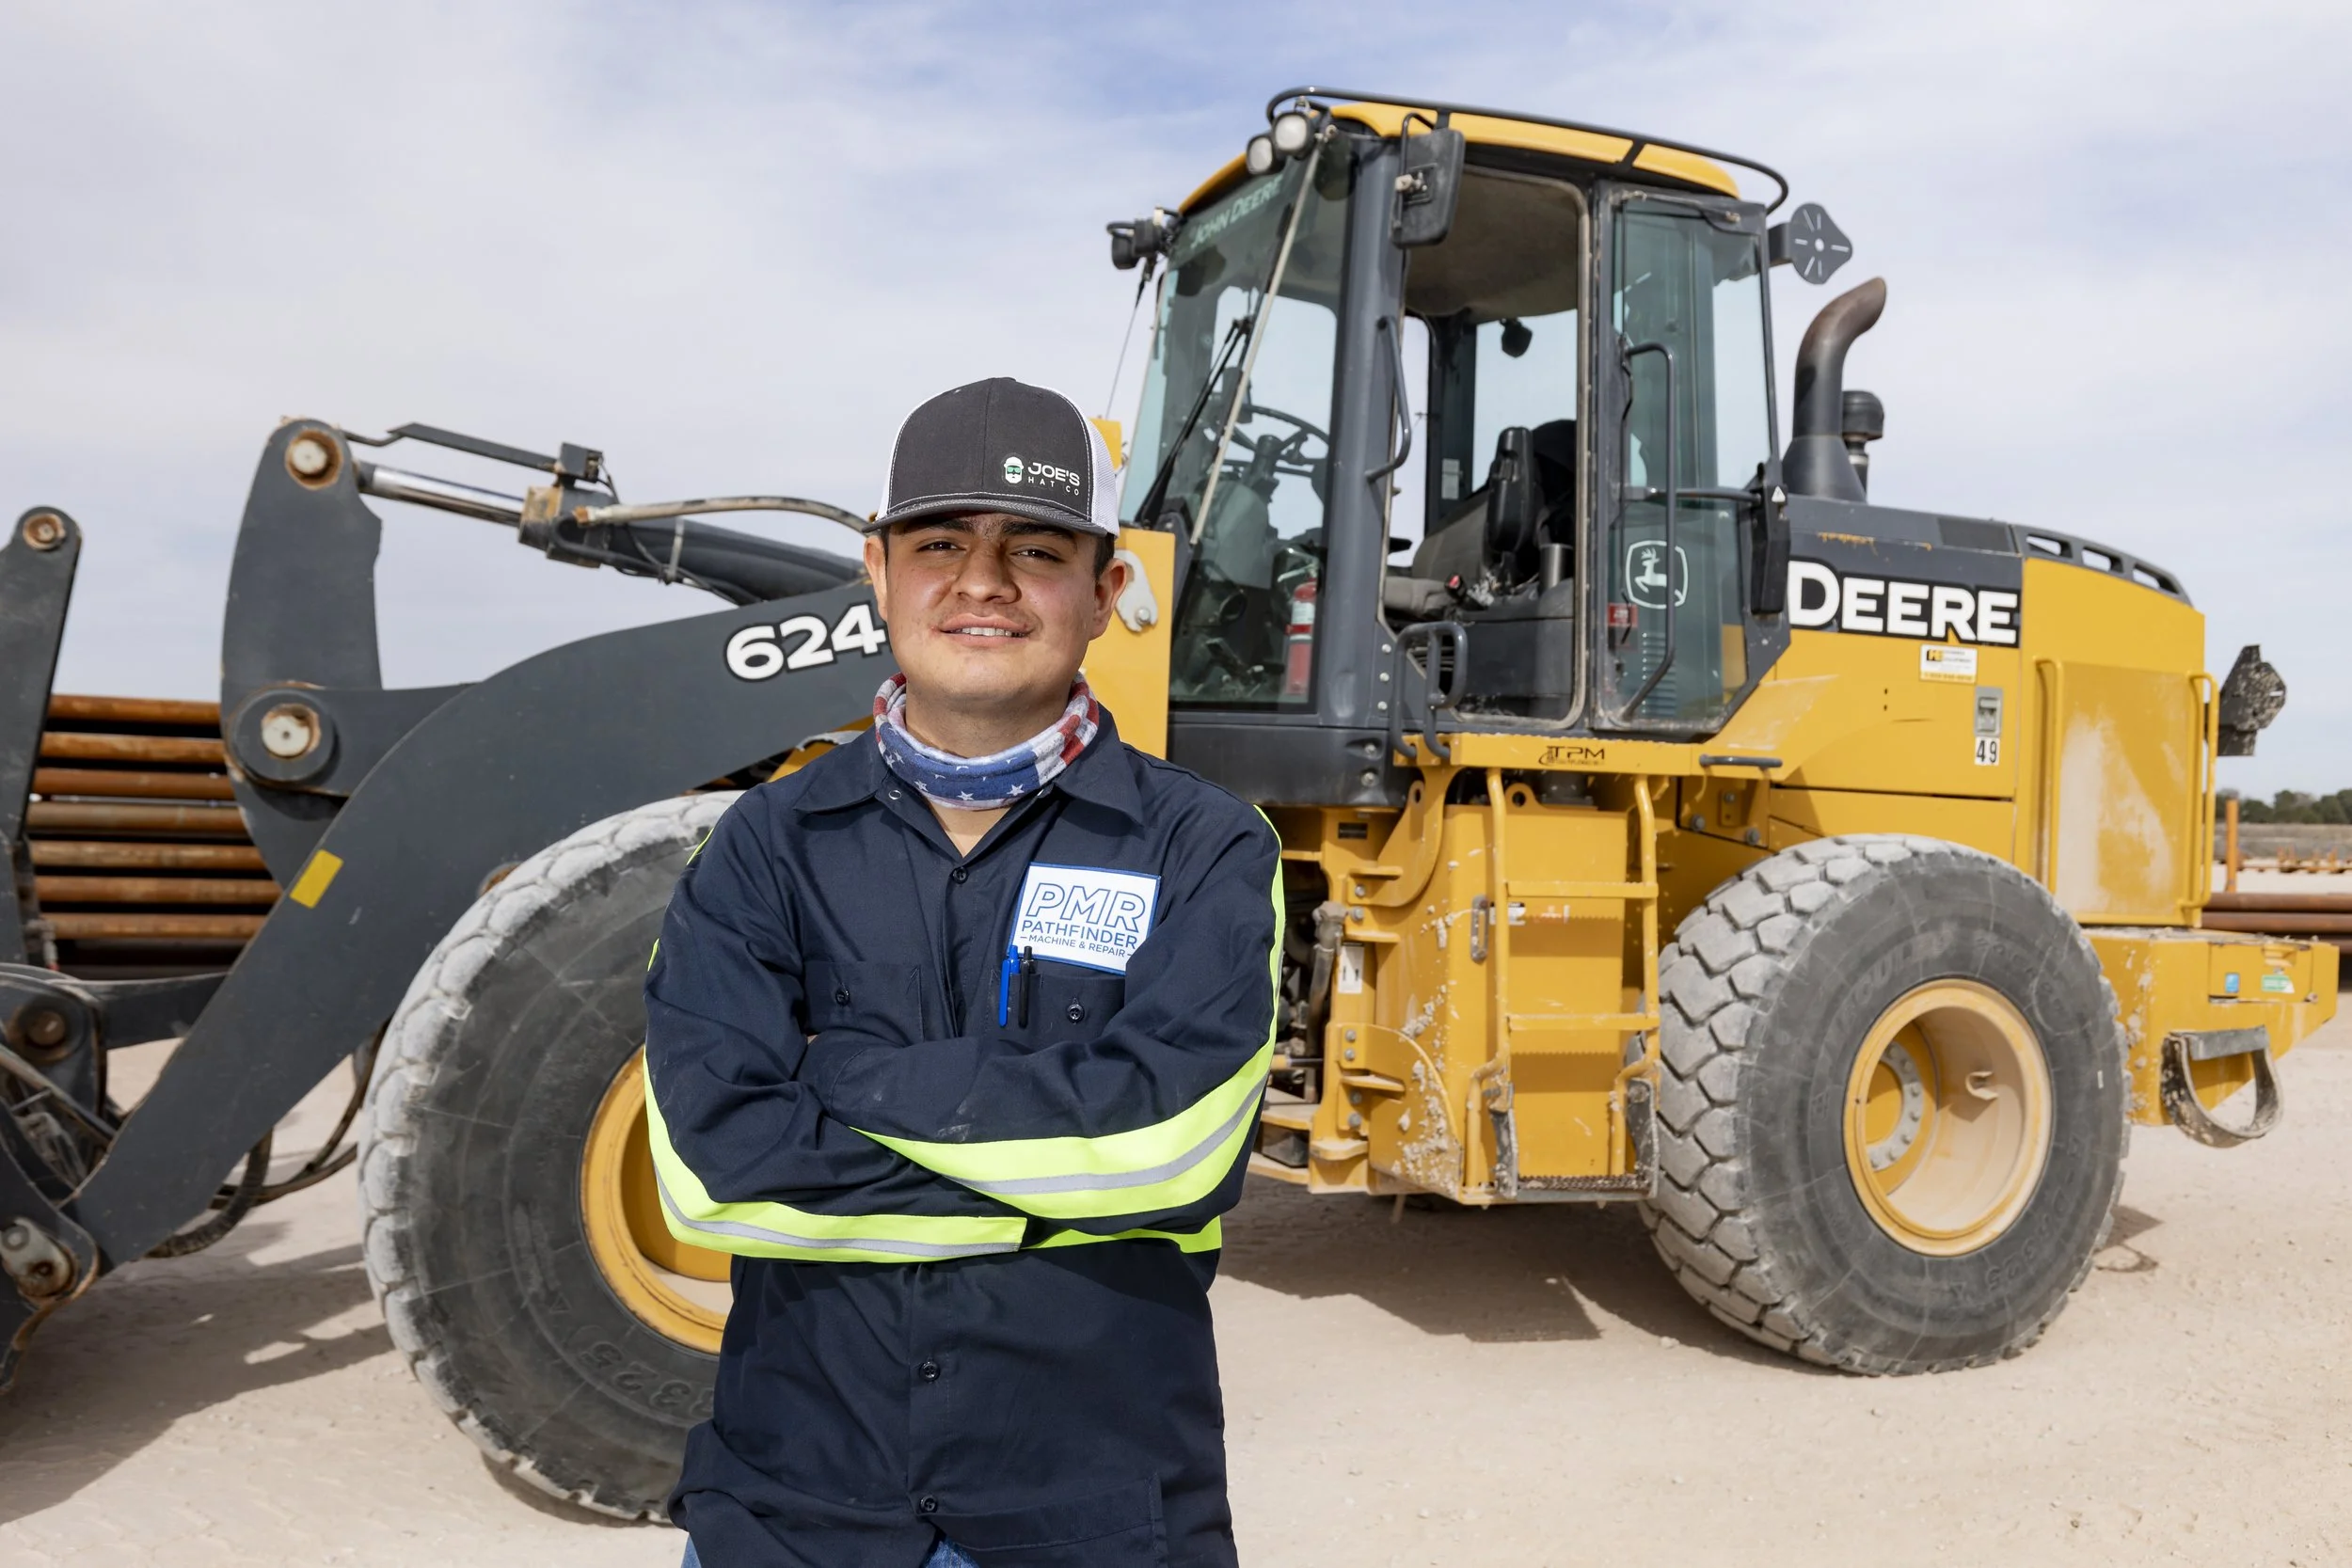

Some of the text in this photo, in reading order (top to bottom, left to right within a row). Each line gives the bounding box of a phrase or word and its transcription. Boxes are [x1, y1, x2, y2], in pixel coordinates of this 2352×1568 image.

[1027, 462, 1080, 486] JOE'S
[1027, 476, 1079, 496] HAT CO
[1787, 559, 2018, 644] DEERE
[726, 603, 886, 680] 624
[1546, 745, 1605, 760] TPM
[1976, 739, 1997, 764] 49
[1025, 882, 1146, 933] PMR
[1022, 920, 1137, 950] PATHFINDER
[1028, 934, 1126, 958] MACHINE & REPAIR
